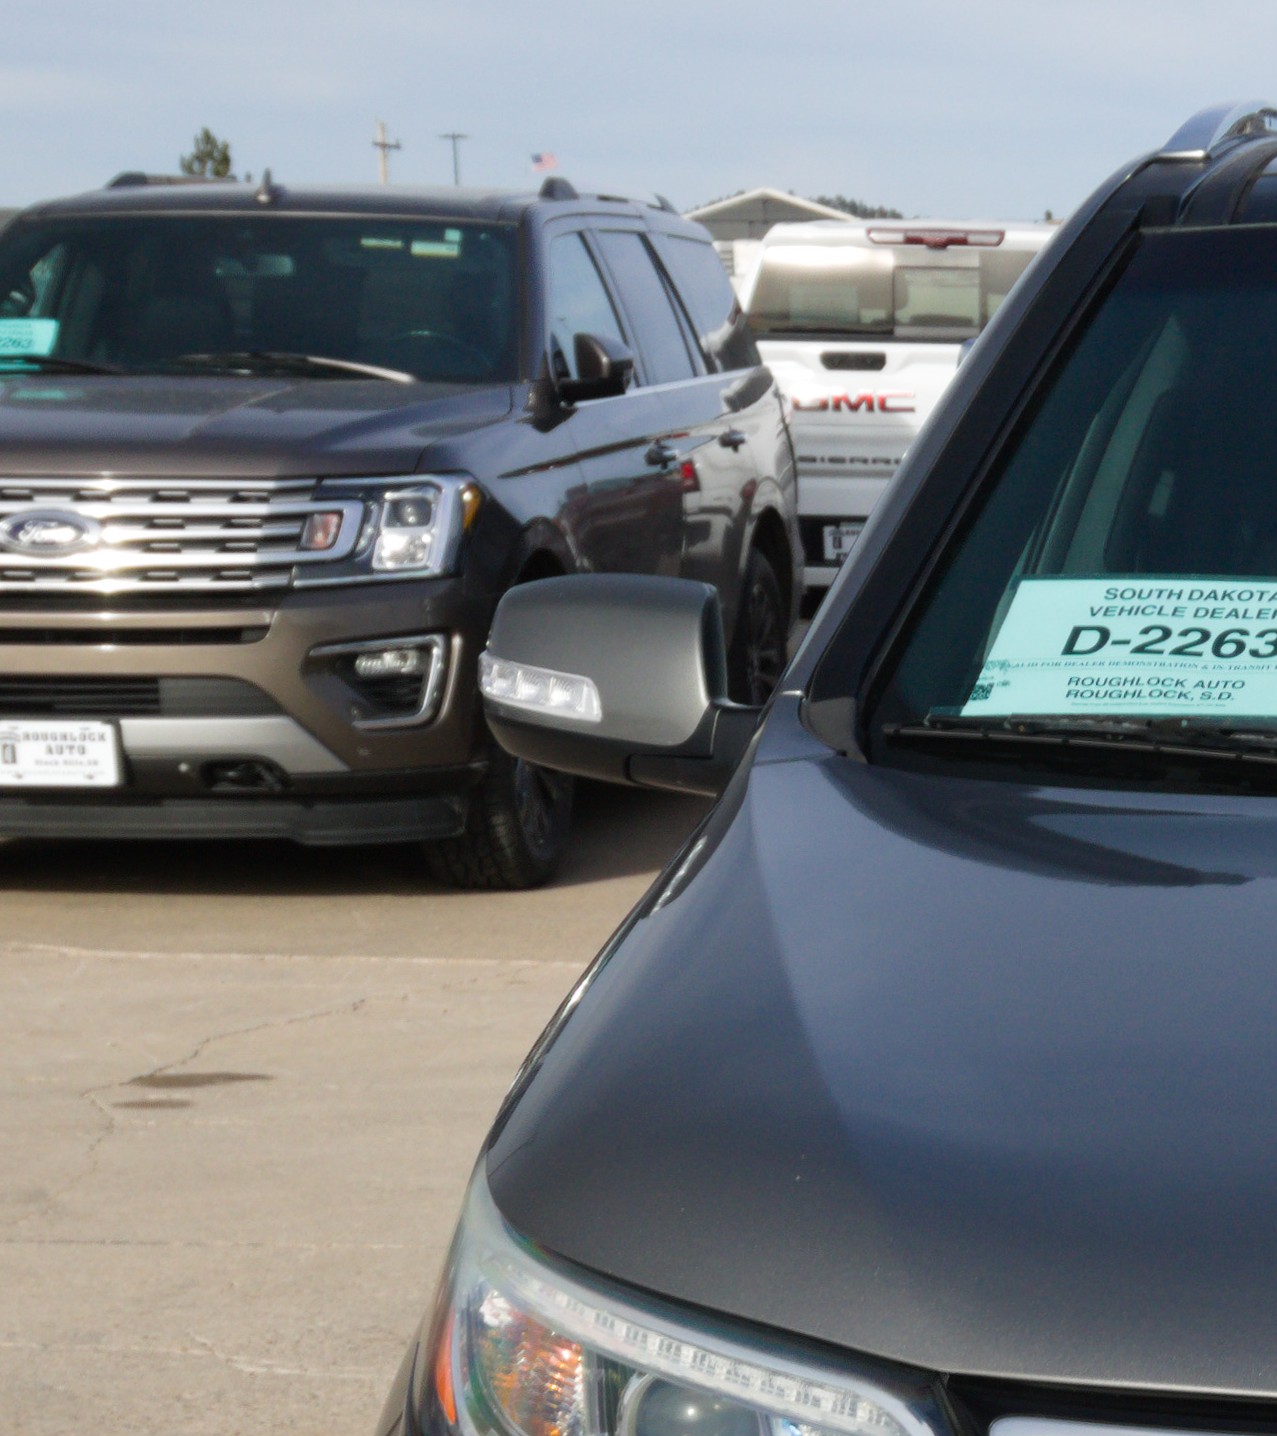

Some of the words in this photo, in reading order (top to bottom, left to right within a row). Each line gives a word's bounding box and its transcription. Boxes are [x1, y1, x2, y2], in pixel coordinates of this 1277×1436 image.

[1104, 588, 1184, 601] SOUTH
[1089, 605, 1187, 617] VEHICLE
[1067, 676, 1187, 689] ROUGHLOCK
[1193, 679, 1246, 690] AUTO
[1065, 689, 1195, 701] ROUGHLOCK,
[1199, 691, 1236, 701] S.D.
[46, 744, 86, 755] AUTO
